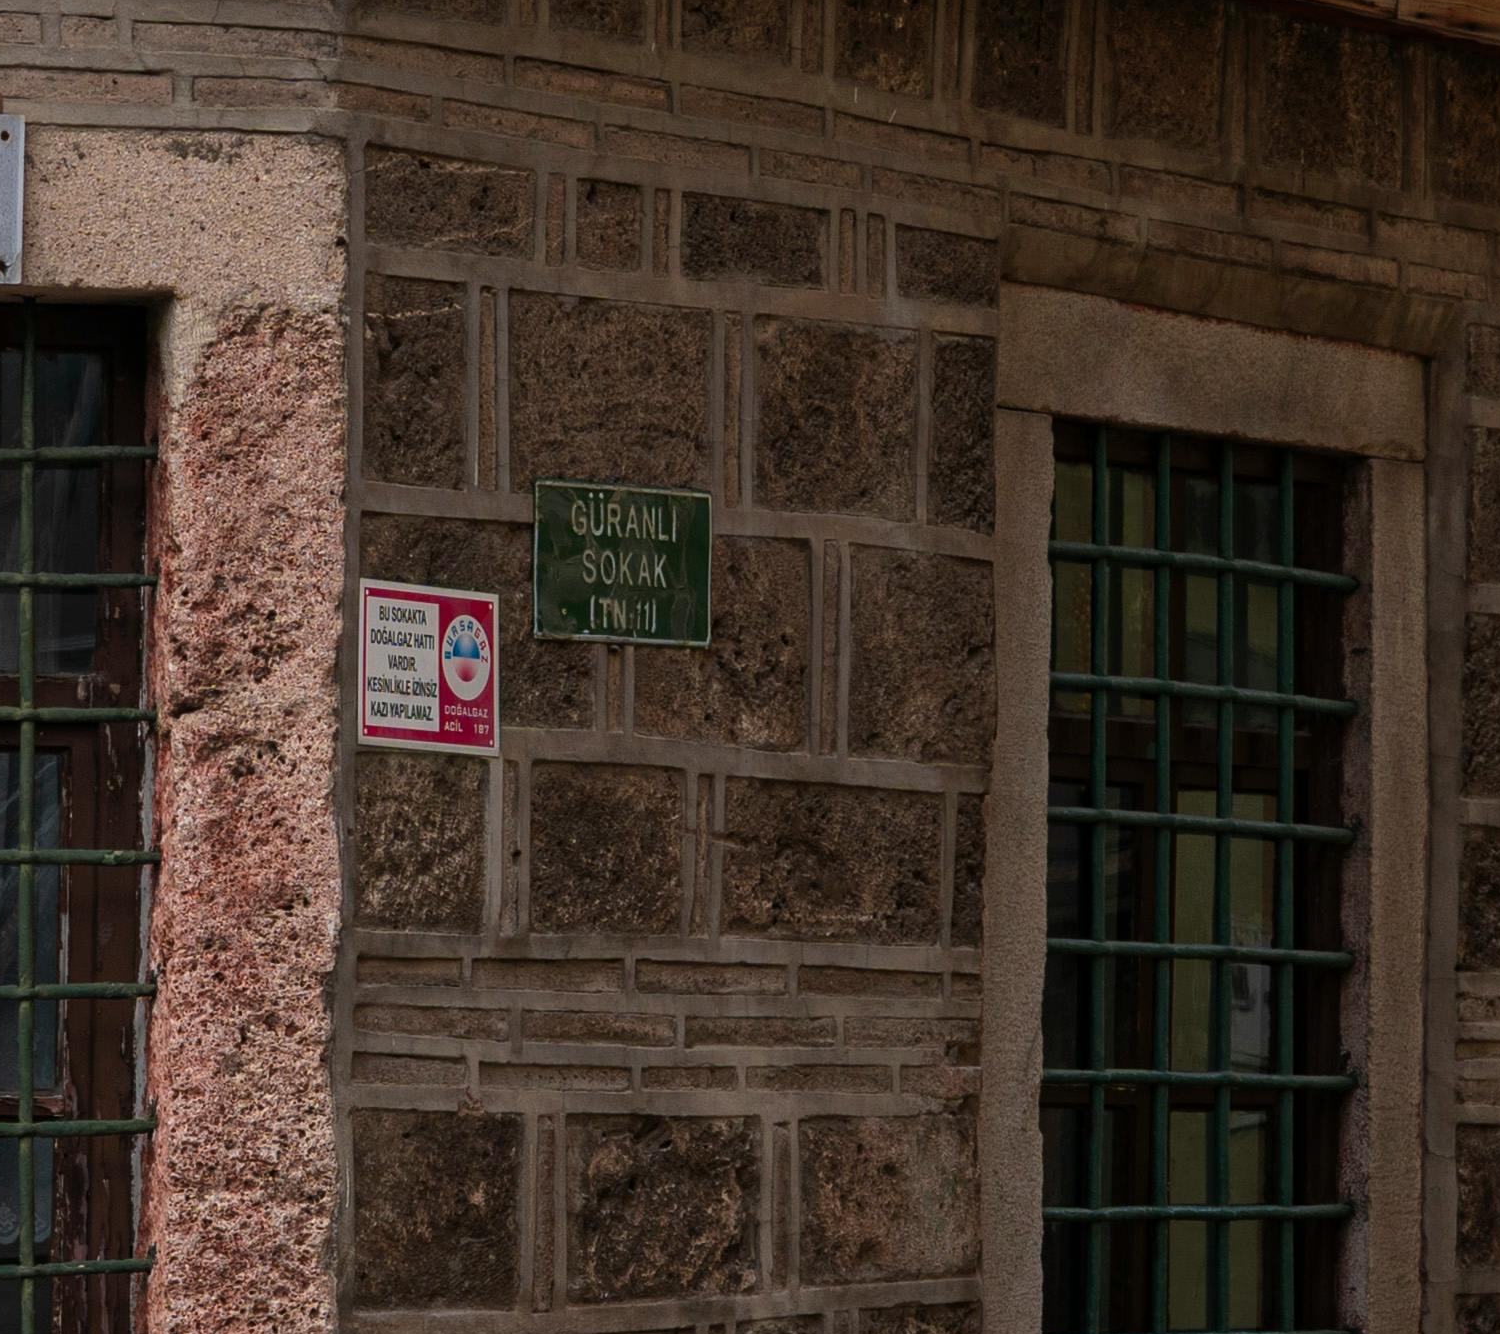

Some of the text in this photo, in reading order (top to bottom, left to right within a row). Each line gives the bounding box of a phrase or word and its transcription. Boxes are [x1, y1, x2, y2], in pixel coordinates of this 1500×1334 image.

[571, 492, 677, 543] GÜRANLI
[582, 549, 667, 588] SOKAK
[379, 605, 427, 626] BU SOKAKTA
[370, 627, 435, 650] DOĞALGAZ HATTI
[367, 674, 411, 696] KESİNLİKLE
[370, 700, 389, 717] KAZI
[444, 703, 489, 718] DOĞALGAZ
[444, 720, 490, 735] ACİL 187
